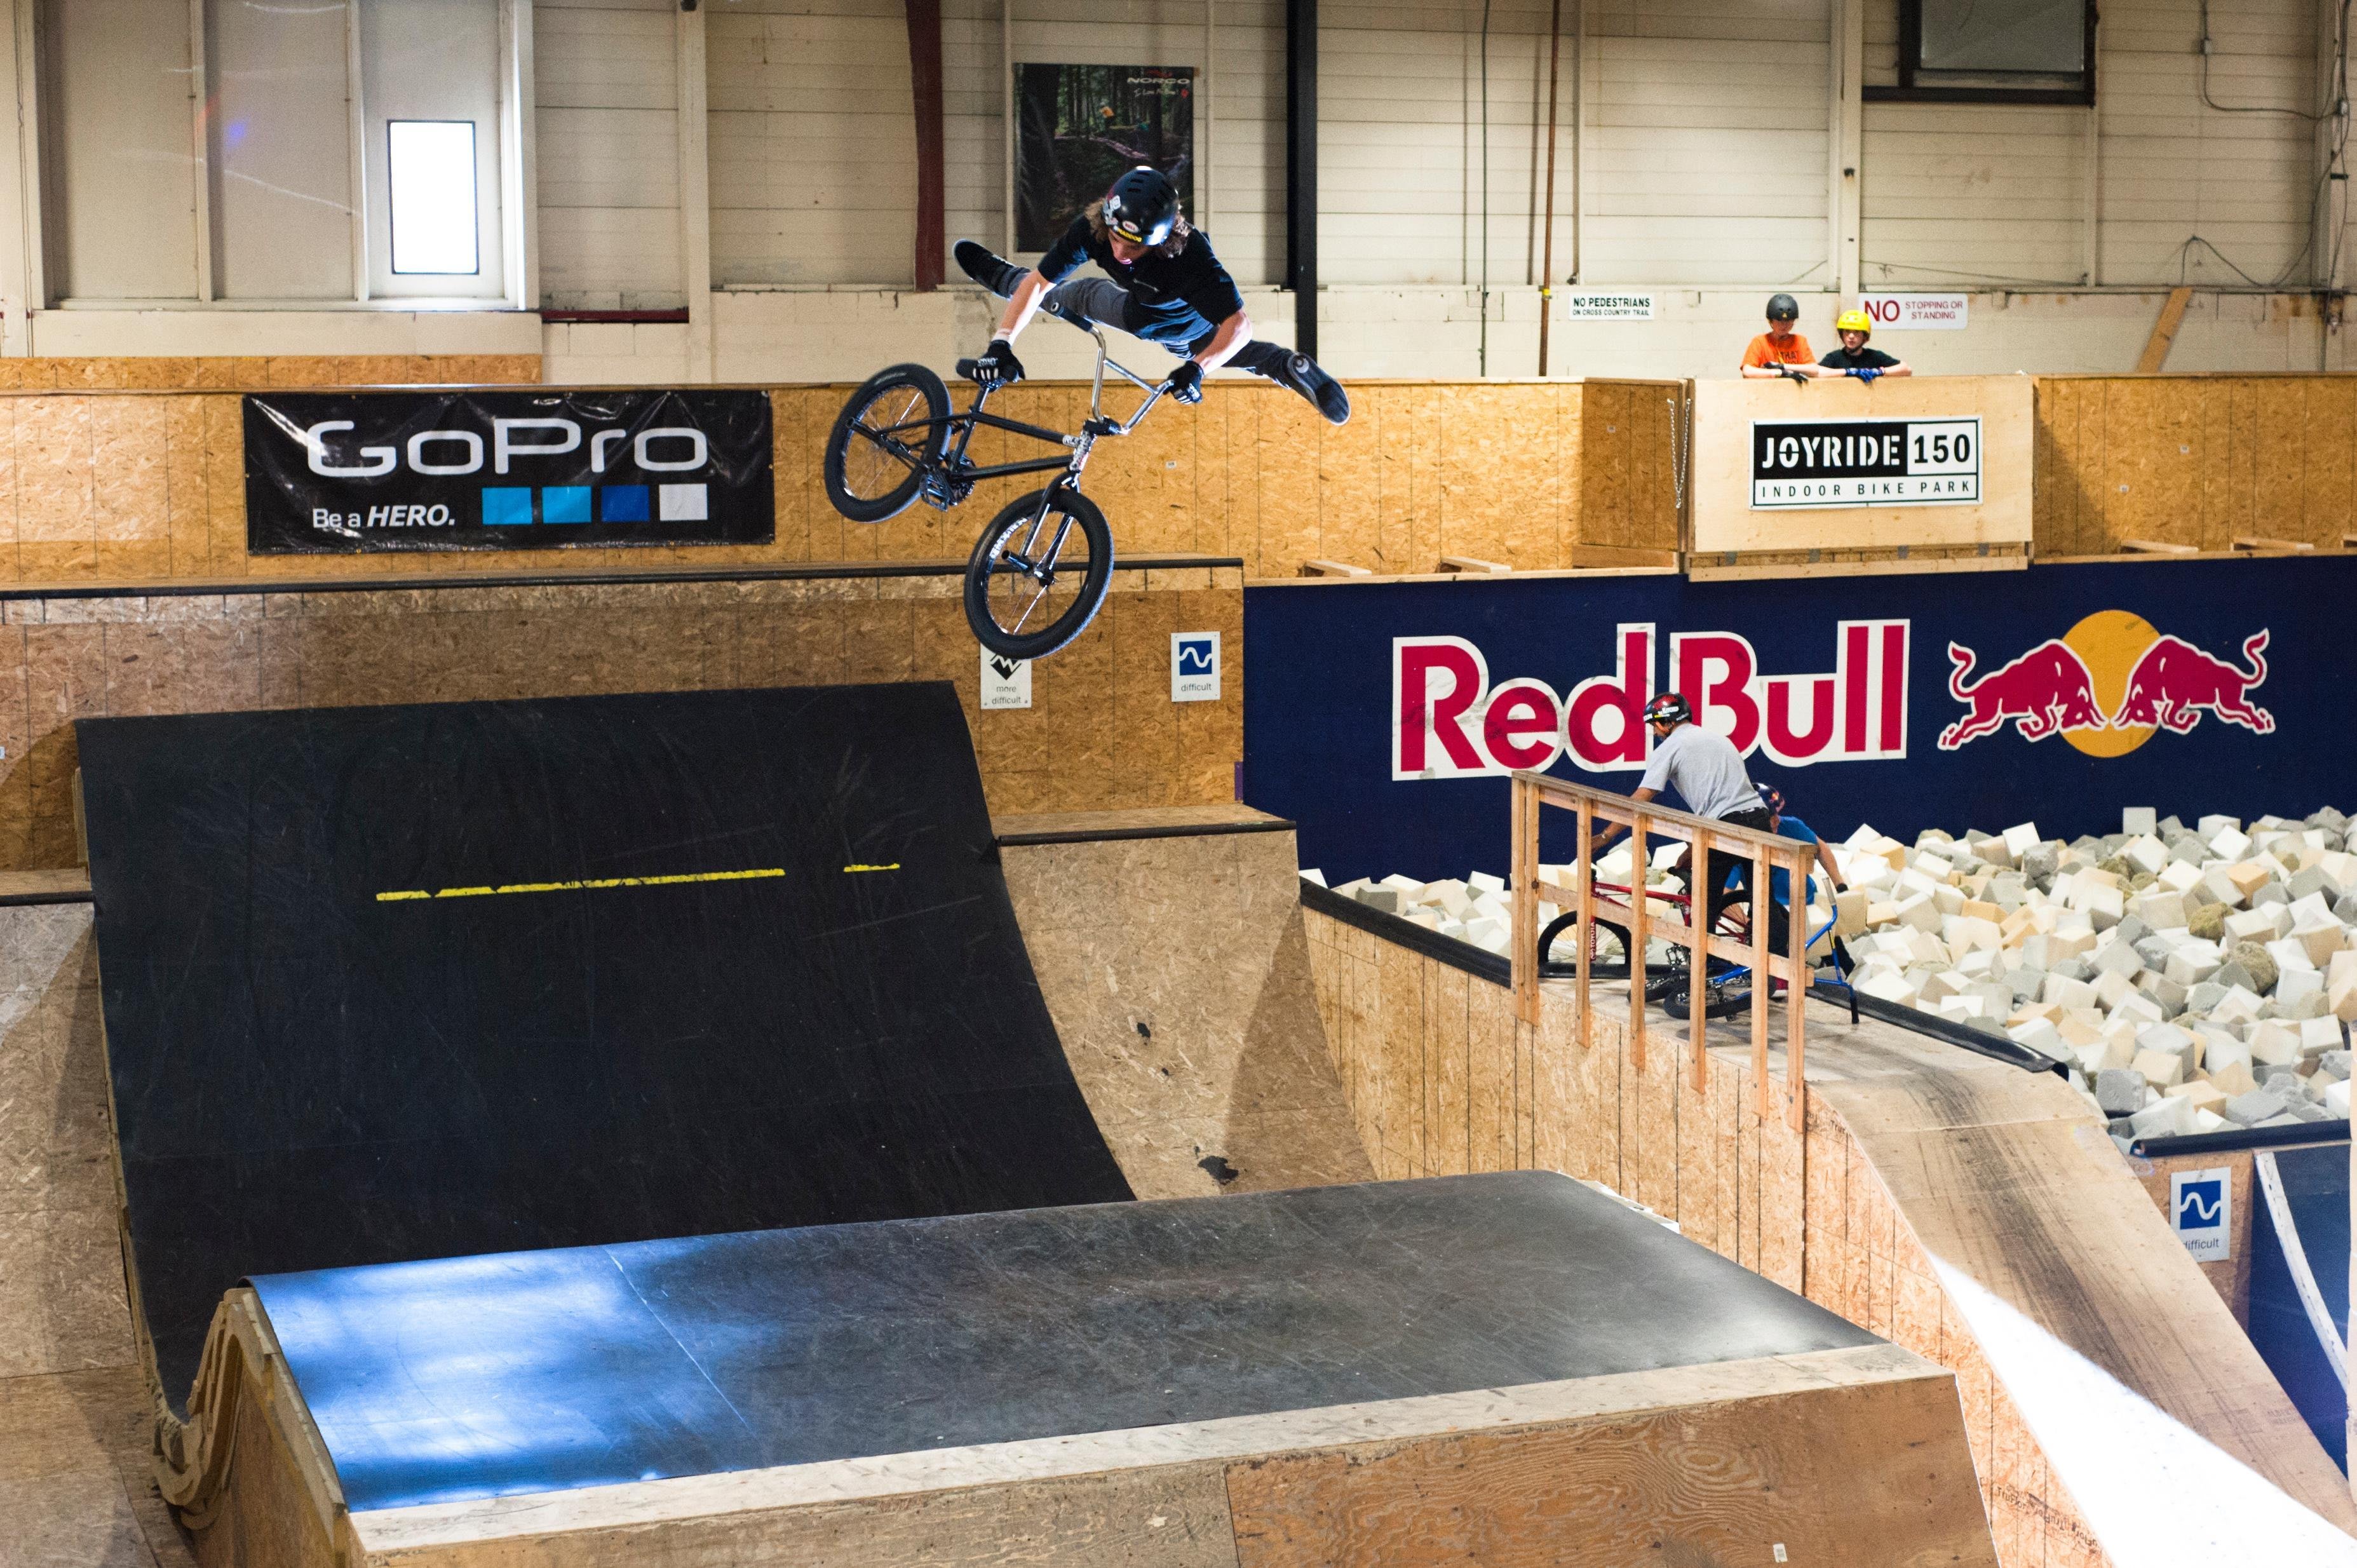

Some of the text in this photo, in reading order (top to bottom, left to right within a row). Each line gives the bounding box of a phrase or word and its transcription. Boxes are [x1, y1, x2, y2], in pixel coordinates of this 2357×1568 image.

[1573, 297, 1651, 308] NO PEDESTRIANS
[1865, 300, 1900, 322] NO
[1905, 301, 1964, 309] STOPPING OR
[1911, 311, 1956, 320] STANDING
[307, 417, 708, 477] GoPro
[1762, 433, 1971, 468] JOYRIDE 150
[1762, 480, 1970, 497] INDOOR BIKE PARK
[312, 504, 456, 529] Be a HERO.
[1180, 682, 1212, 693] difficult
[991, 696, 1022, 706] difficult
[1400, 625, 1905, 773] Red Bull
